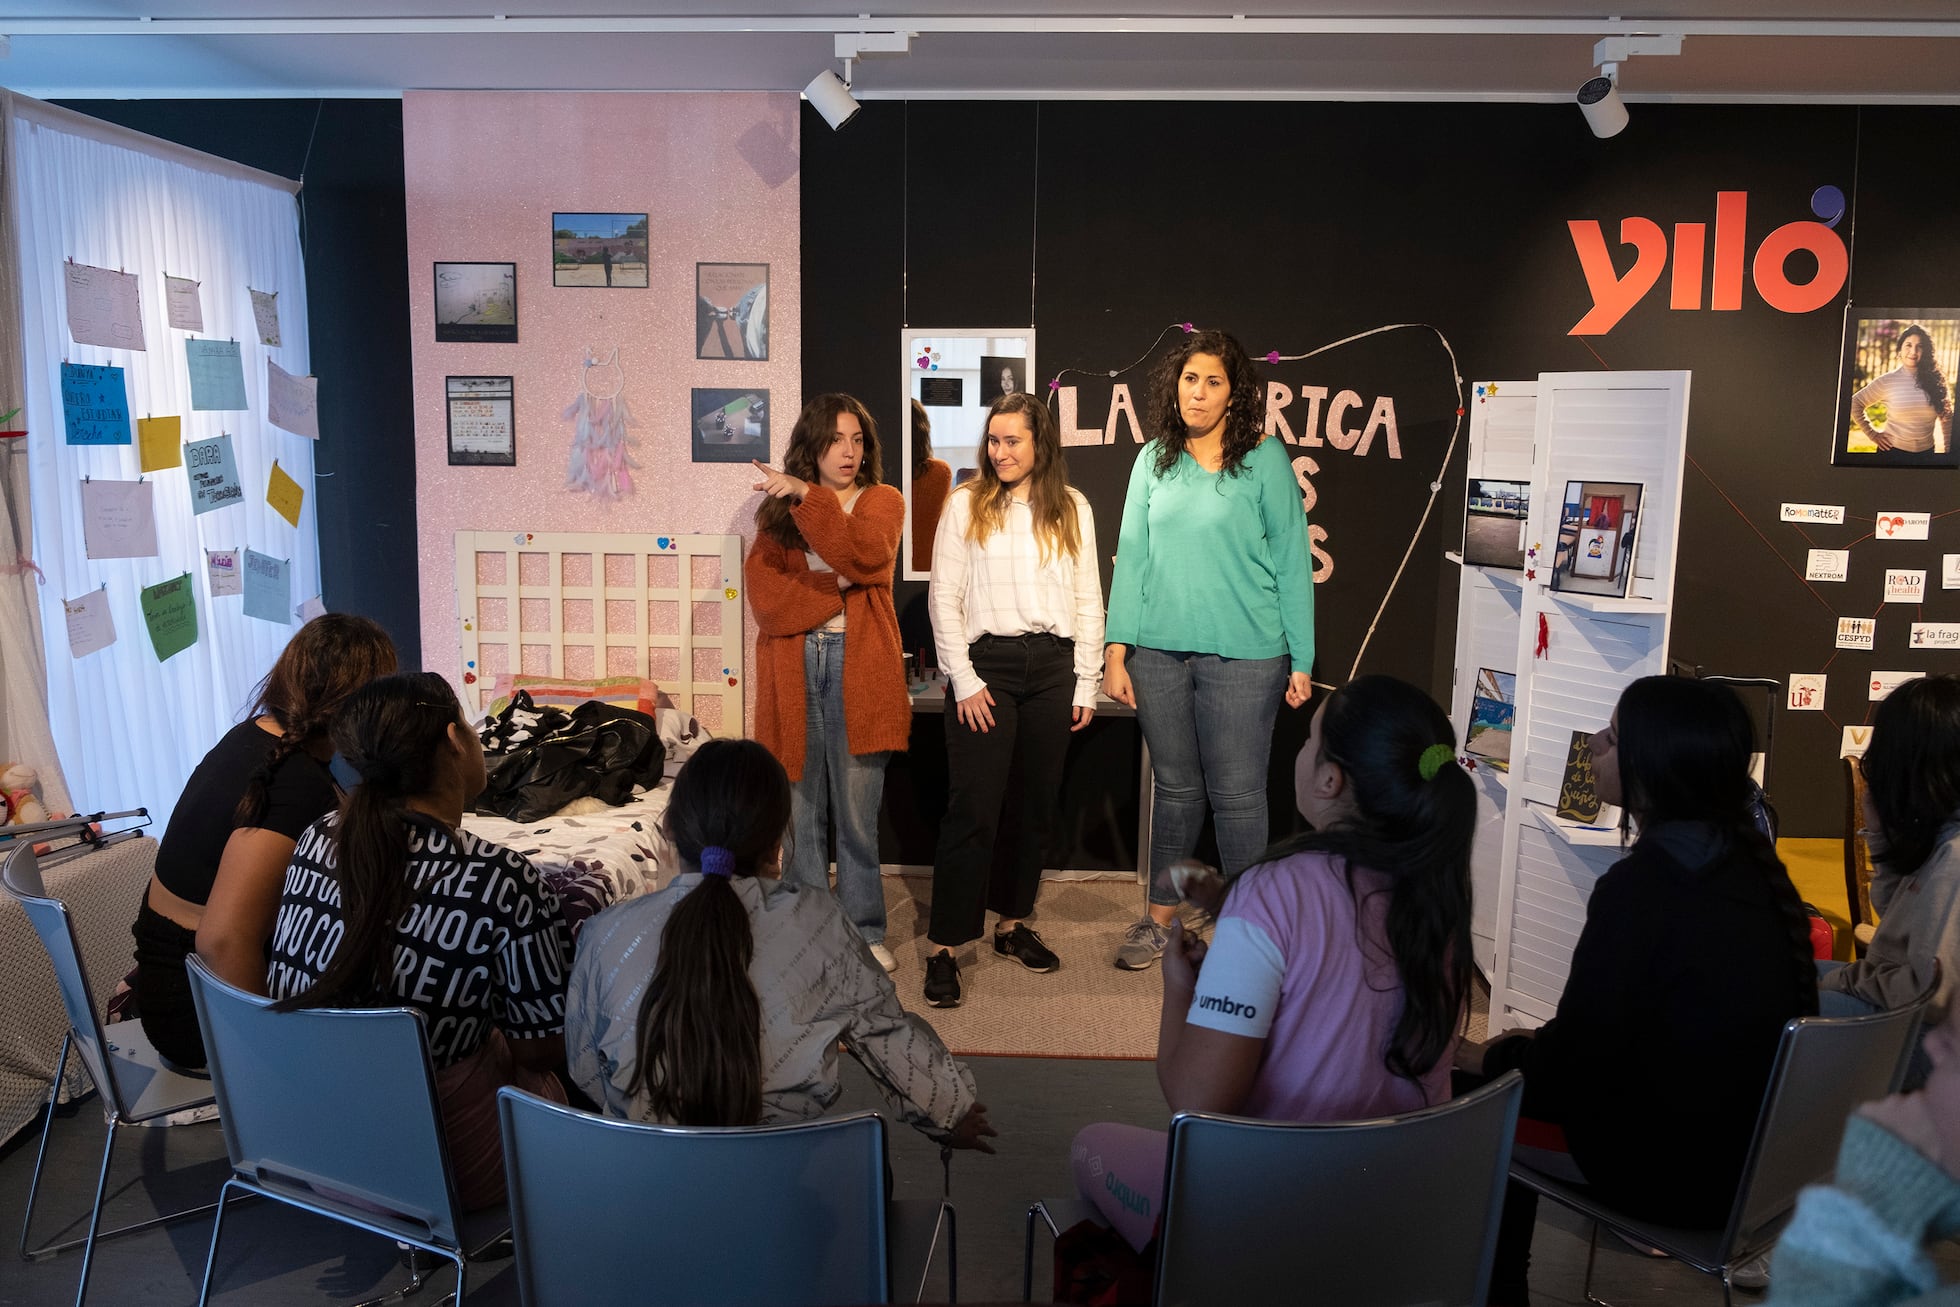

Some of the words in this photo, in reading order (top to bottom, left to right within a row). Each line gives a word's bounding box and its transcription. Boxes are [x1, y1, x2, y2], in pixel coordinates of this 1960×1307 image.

[1058, 383, 1144, 448] LA
[1263, 381, 1402, 460] RICA
[1809, 572, 1843, 580] NEXTROM
[1891, 586, 1920, 594] health
[1837, 634, 1872, 643] CESPYD
[1926, 629, 1936, 639] la
[1199, 995, 1256, 1019] umbro
